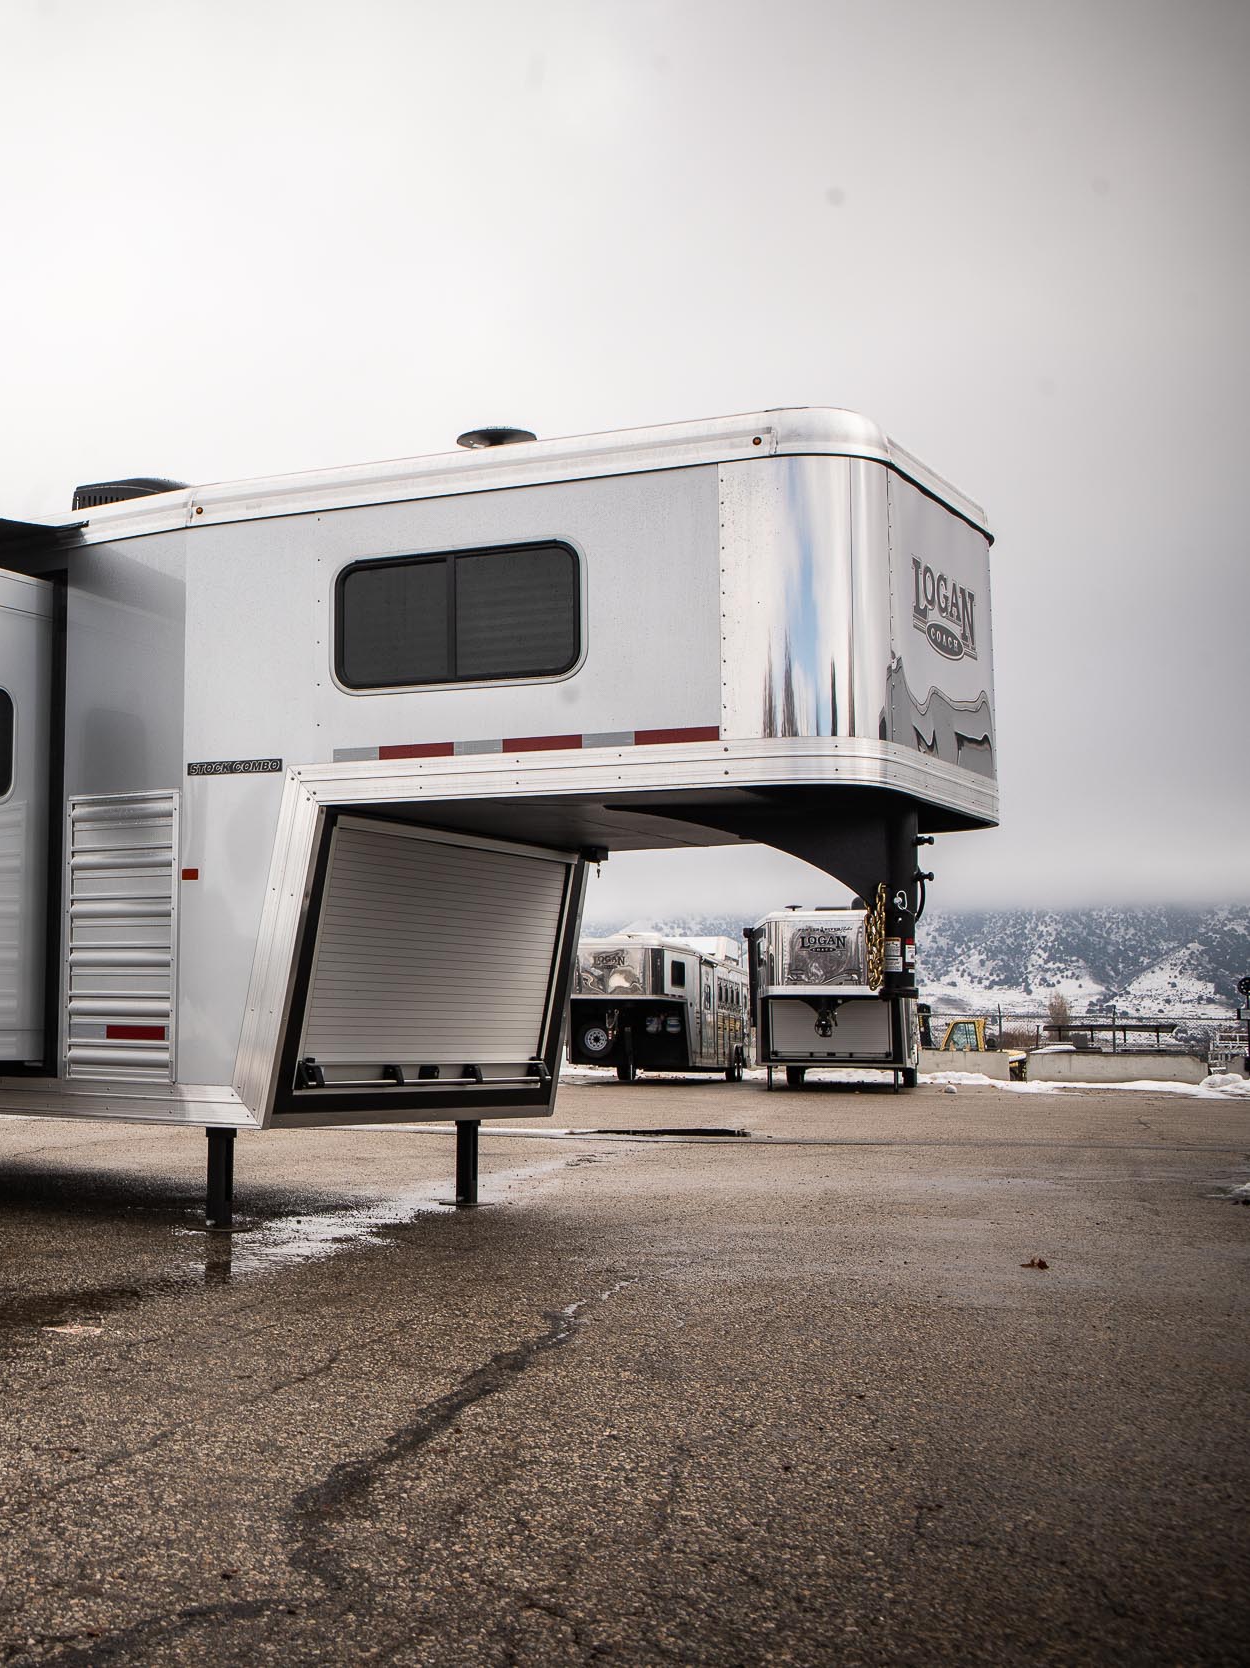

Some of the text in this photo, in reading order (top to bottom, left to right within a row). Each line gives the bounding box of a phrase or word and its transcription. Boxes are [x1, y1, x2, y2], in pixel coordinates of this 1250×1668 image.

[910, 553, 976, 651] LOGAN
[929, 627, 960, 653] COACH
[190, 760, 280, 775] STOCK COMBO
[799, 935, 847, 949] LOGAN
[592, 955, 626, 966] LOGAN
